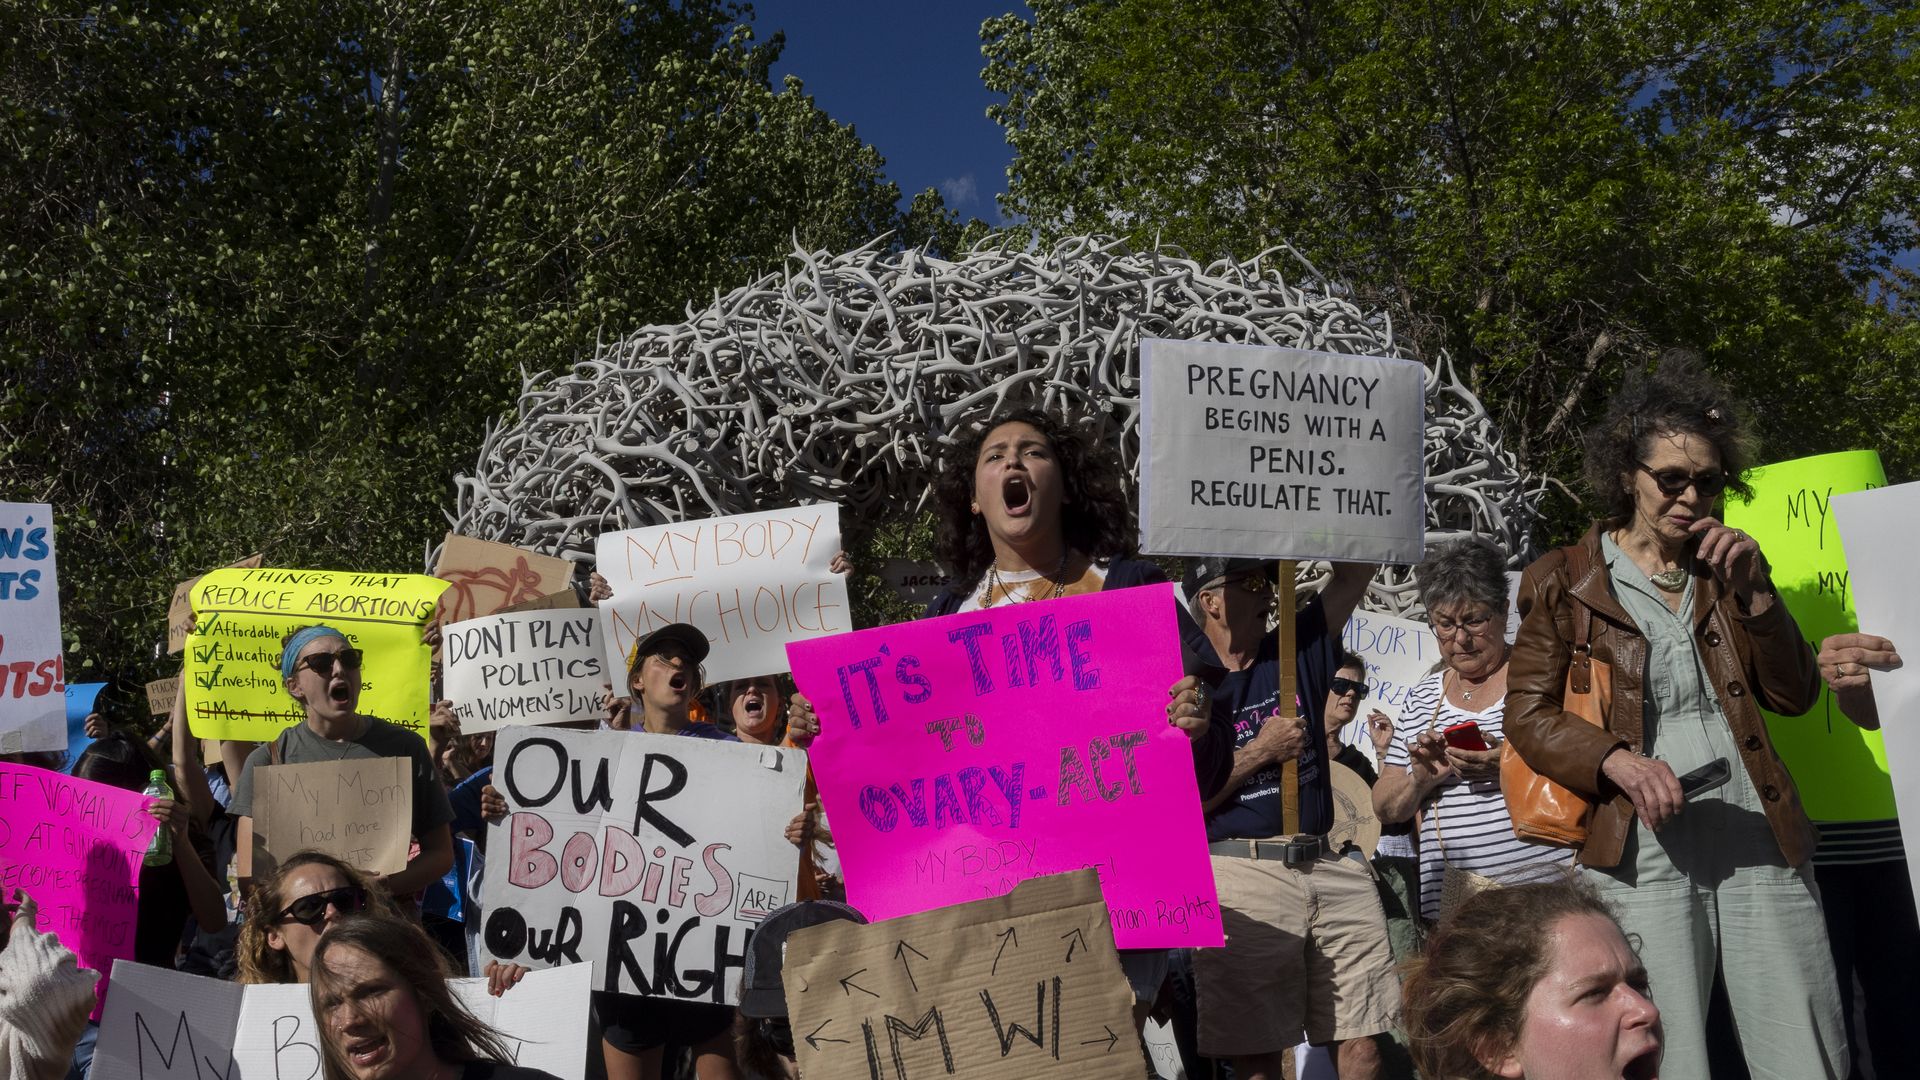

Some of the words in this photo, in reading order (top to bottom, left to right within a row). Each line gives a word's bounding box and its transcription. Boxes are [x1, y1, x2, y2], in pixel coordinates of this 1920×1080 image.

[1187, 364, 1380, 410] PREGNANCY
[1205, 407, 1290, 434] BEGINS
[1304, 414, 1361, 439] WITH
[1369, 418, 1387, 442] A
[1250, 445, 1345, 475] PENIS.
[1191, 480, 1322, 511] REGULATE
[1333, 488, 1392, 516] THAT.
[1786, 486, 1832, 550] MY
[626, 526, 702, 580] MY
[714, 514, 822, 566] BODY
[242, 570, 333, 585] THINGS
[349, 575, 408, 589] THAT
[1818, 570, 1849, 612] MY
[200, 584, 295, 611] REDUCE
[305, 592, 433, 620] ABORTIONS
[689, 581, 841, 644] CHOICE
[212, 620, 280, 640] Affordable
[448, 617, 522, 667] DON'T
[528, 616, 595, 648] PLAY
[1342, 614, 1431, 661] ABORT
[210, 670, 277, 695] Investing
[482, 657, 601, 689] POLITICS
[836, 642, 933, 729] IT'S
[946, 613, 1101, 697] TIME
[1365, 661, 1381, 674] he
[151, 695, 177, 712] PATR
[452, 701, 475, 726] ITH
[476, 687, 564, 721] WOMEN'S
[1366, 676, 1413, 706] PRE
[213, 700, 251, 722] Men
[924, 712, 985, 752] TO
[276, 772, 320, 817] My
[337, 770, 407, 807] Mom
[857, 729, 1149, 833] OVARY-ACT
[1240, 787, 1271, 801] Presented
[38, 776, 116, 831] WOMAN
[121, 807, 149, 840] IS
[24, 822, 56, 850] AT
[299, 820, 337, 844] had
[344, 821, 382, 838] more
[0, 863, 72, 893] ECOMES
[913, 849, 948, 885] MY
[953, 838, 1037, 877] BODY
[740, 887, 779, 911] ARE
[1109, 907, 1148, 929] man
[1154, 895, 1215, 934] Rights
[979, 976, 1064, 1062] WI
